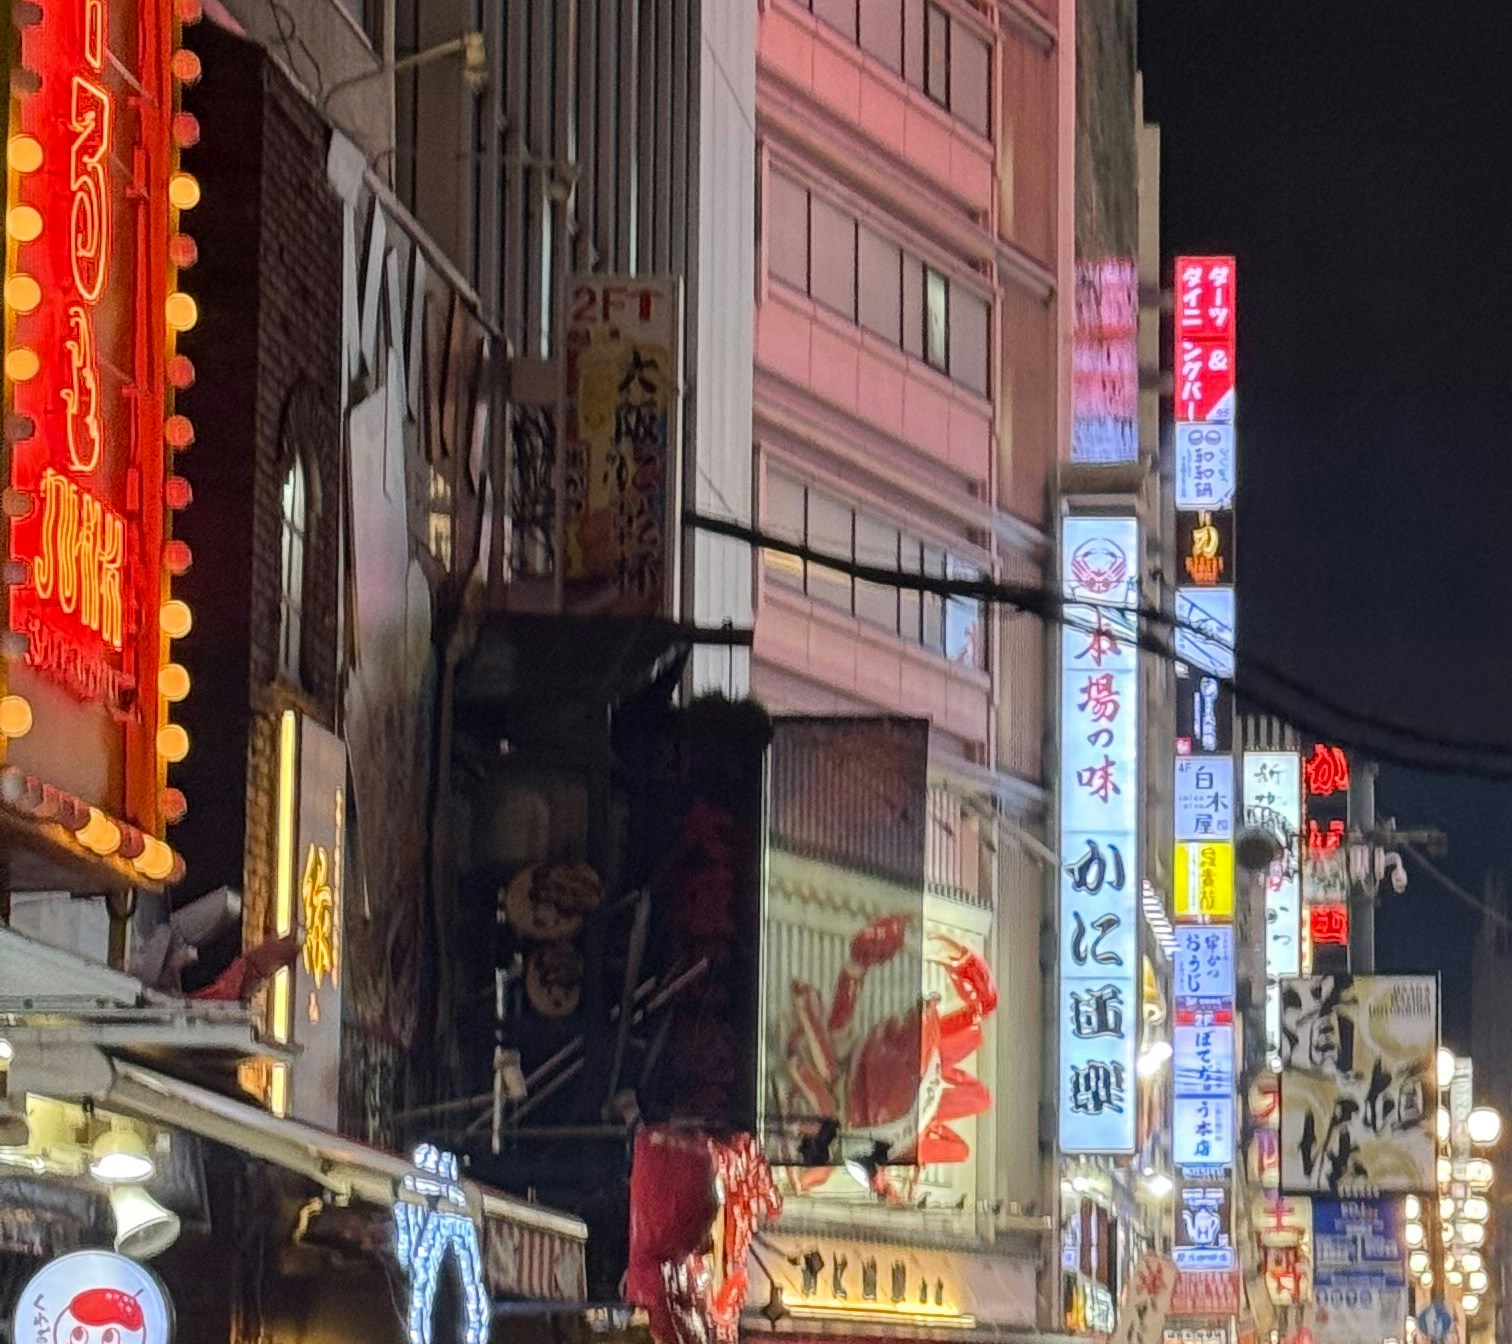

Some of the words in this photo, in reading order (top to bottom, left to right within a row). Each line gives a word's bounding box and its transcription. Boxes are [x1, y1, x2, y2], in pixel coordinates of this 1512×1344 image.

[1074, 610, 1121, 804] 本場の味
[1193, 765, 1229, 835] 白木屋
